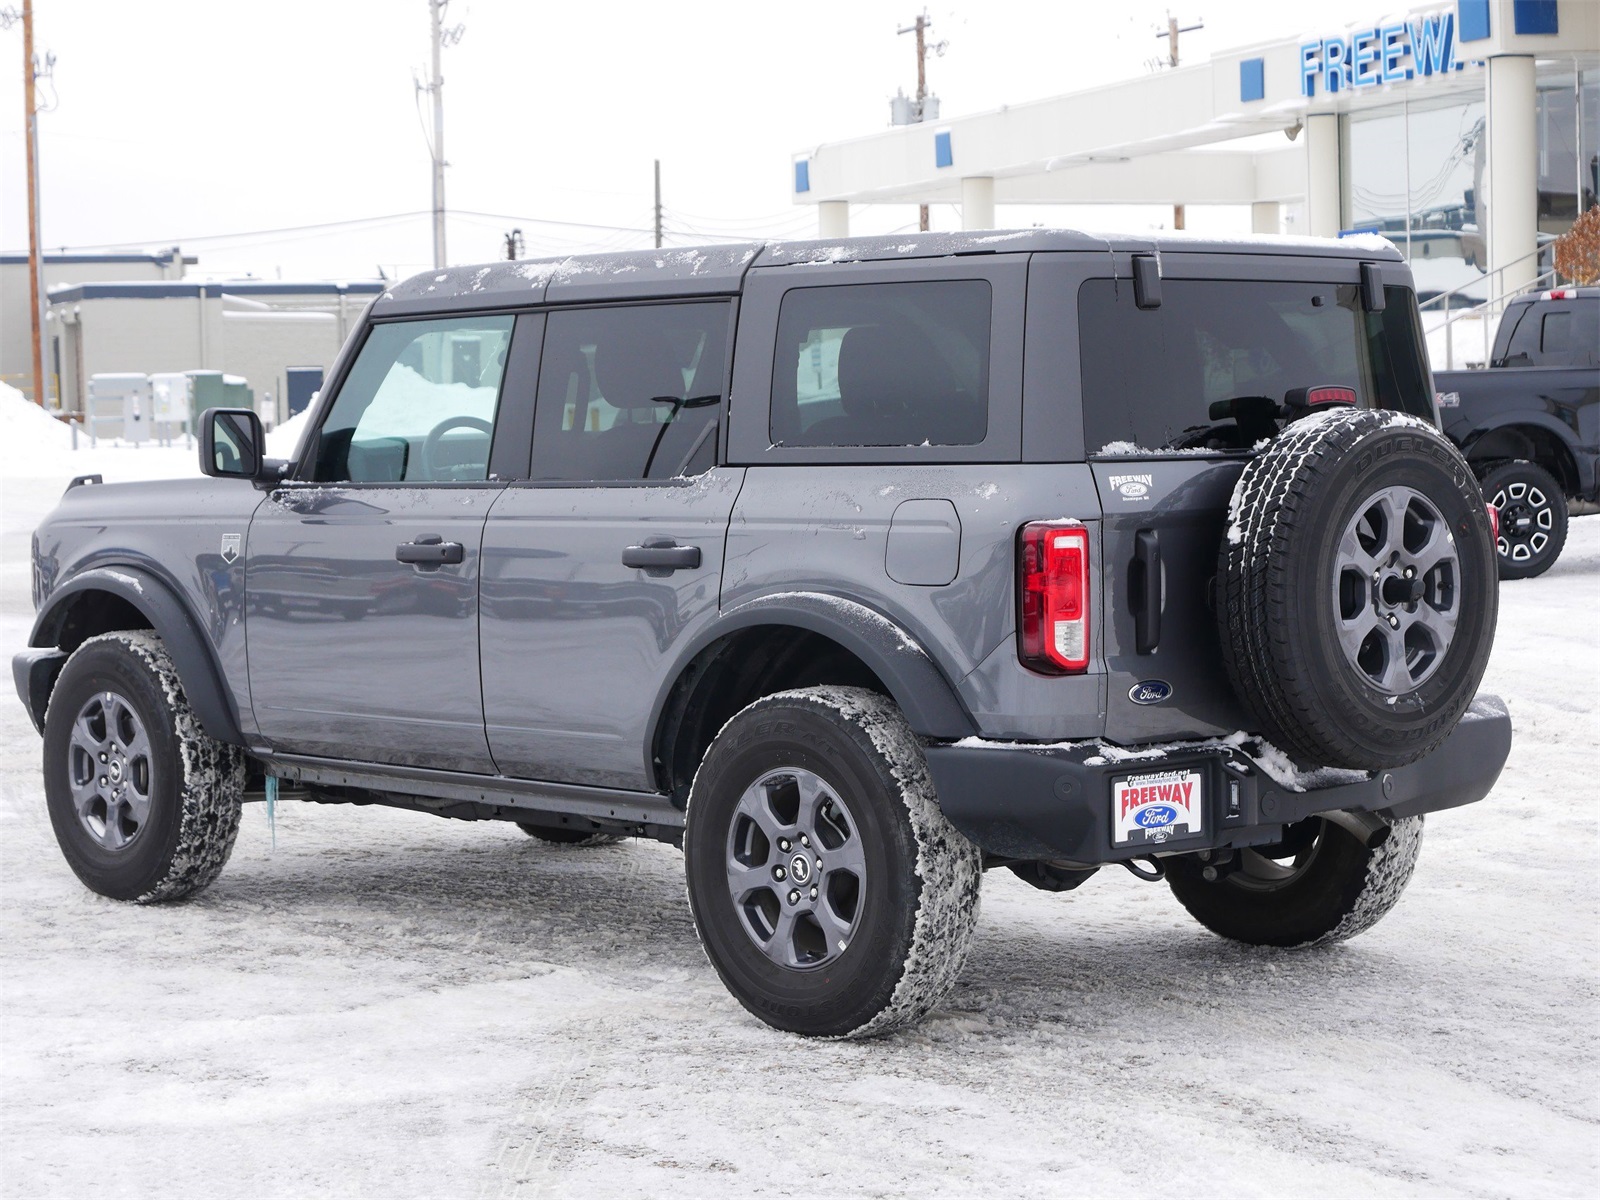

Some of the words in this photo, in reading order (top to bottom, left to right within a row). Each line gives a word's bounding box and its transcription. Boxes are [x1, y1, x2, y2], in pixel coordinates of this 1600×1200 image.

[1300, 13, 1484, 97] FREEW
[1109, 474, 1152, 491] FREEWAY
[1140, 686, 1162, 700] Ford
[1127, 769, 1190, 781] FreewayFord.net
[1121, 782, 1193, 822] FREEWAY
[1142, 808, 1170, 825] Ford
